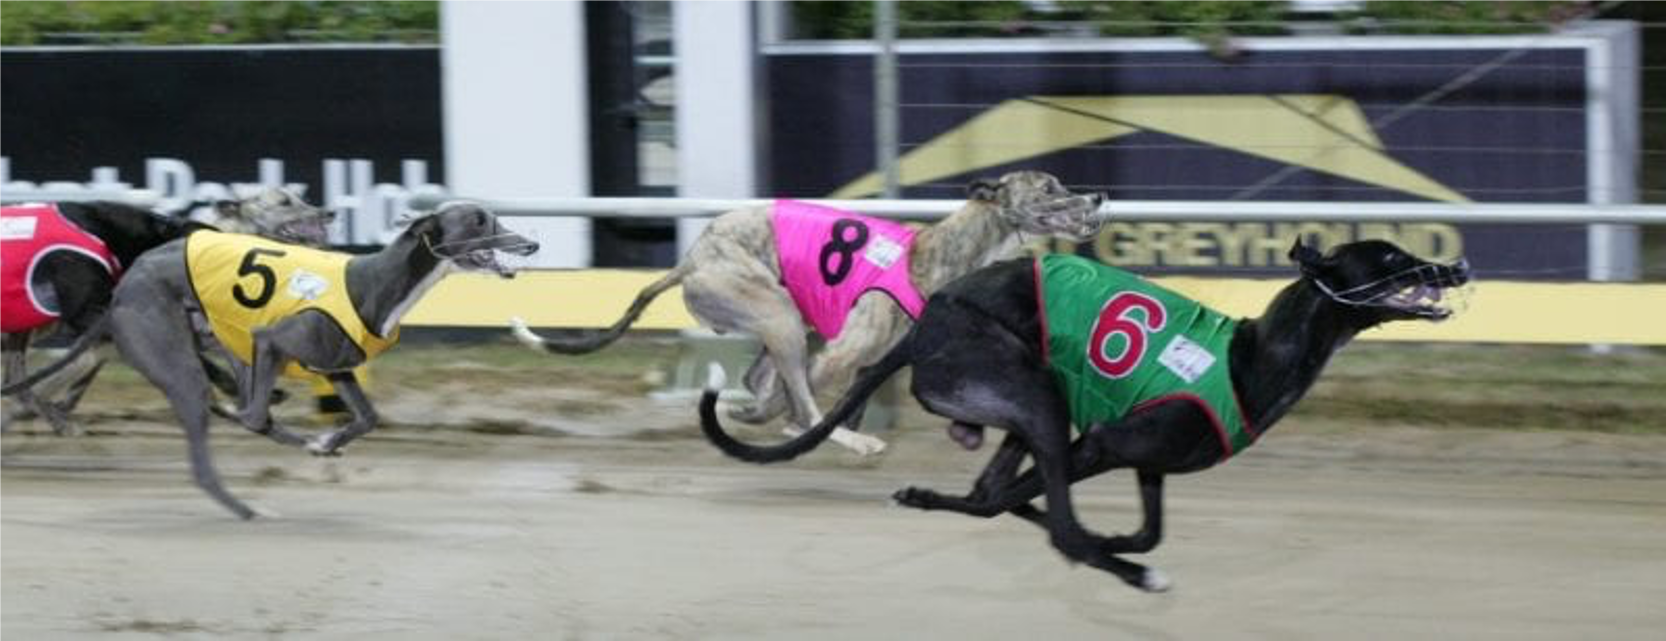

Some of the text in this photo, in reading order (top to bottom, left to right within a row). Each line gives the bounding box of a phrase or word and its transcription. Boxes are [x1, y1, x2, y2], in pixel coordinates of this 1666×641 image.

[232, 247, 287, 310] 5
[820, 218, 869, 286] 8
[1087, 291, 1167, 379] 6
